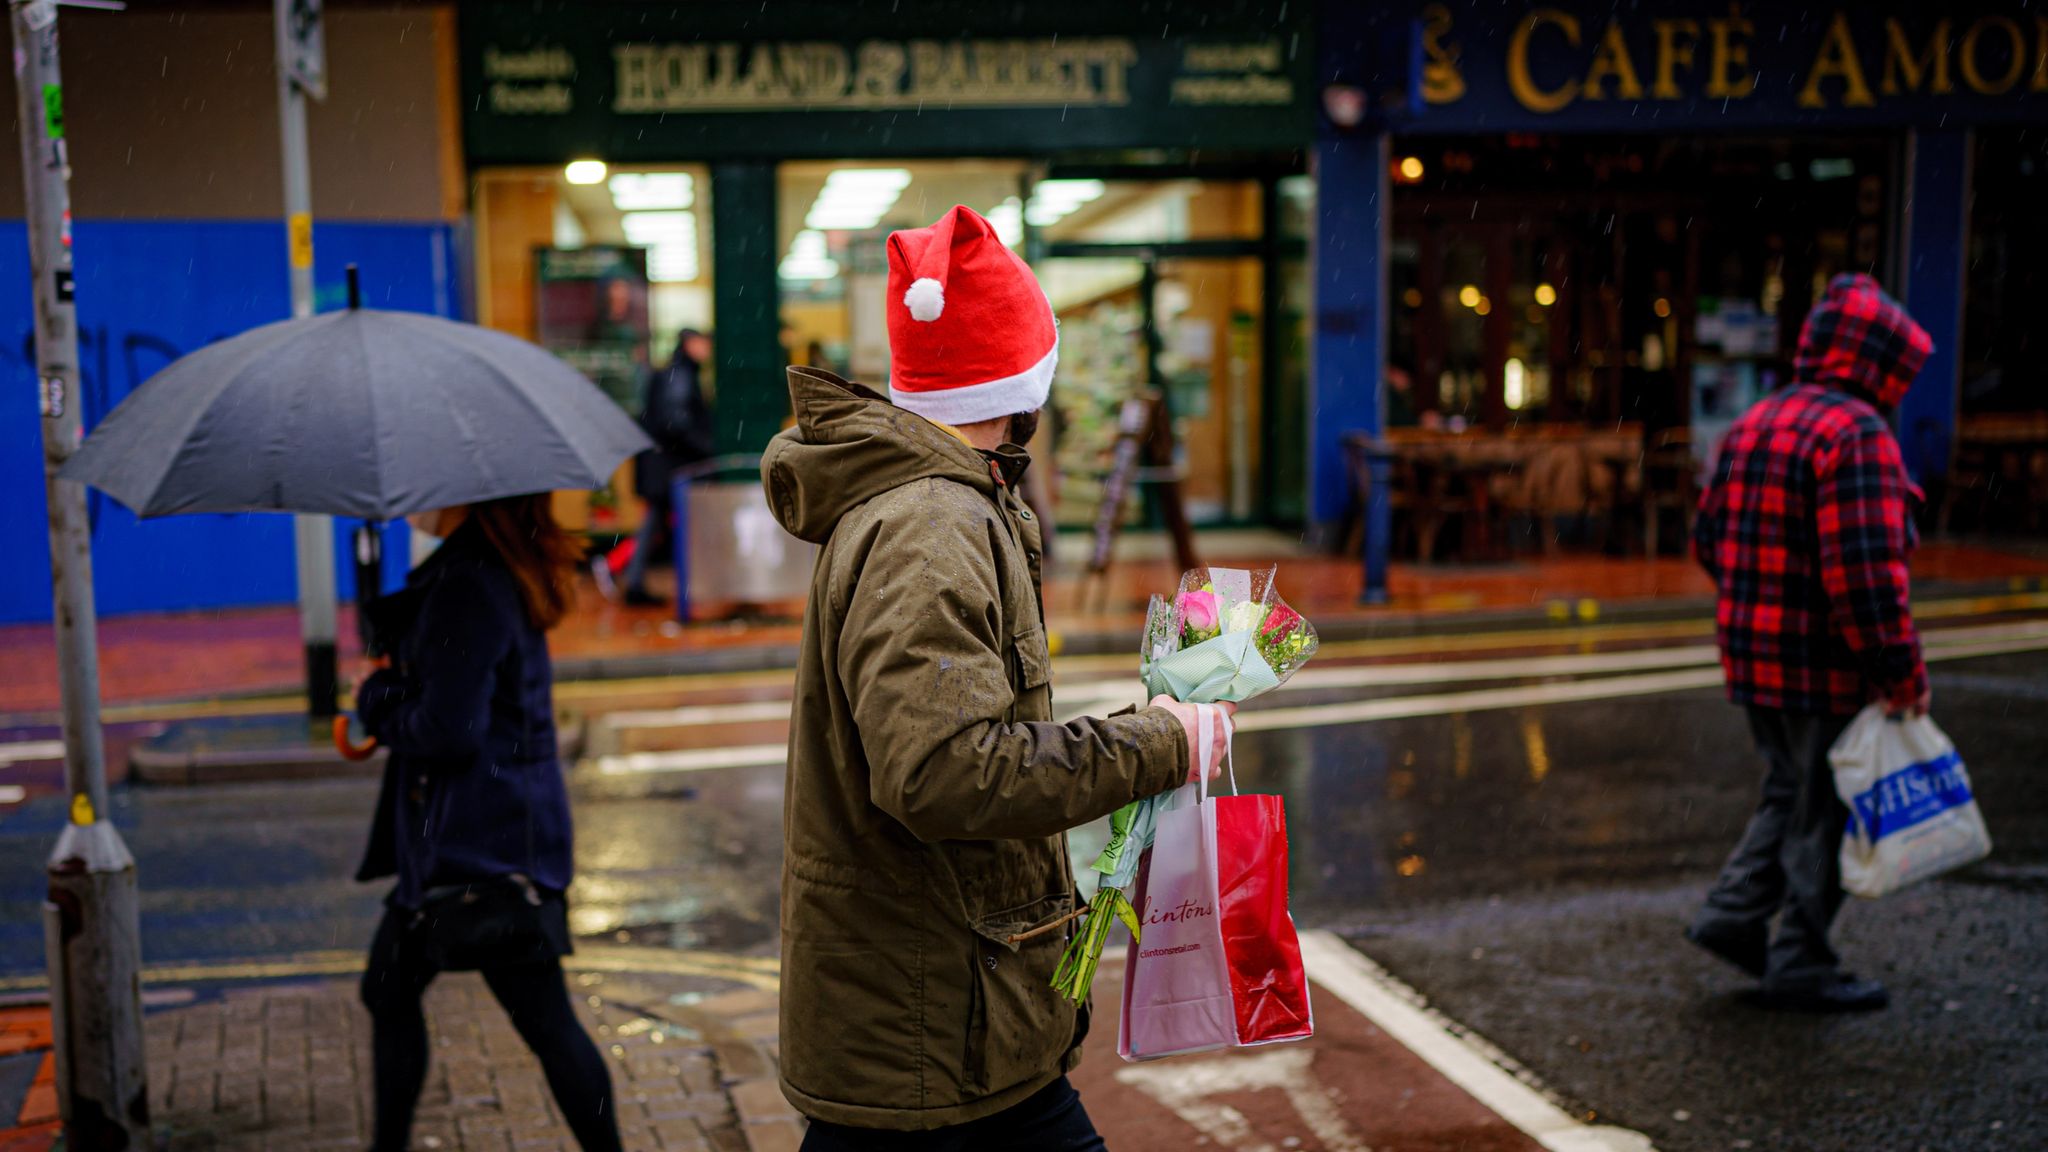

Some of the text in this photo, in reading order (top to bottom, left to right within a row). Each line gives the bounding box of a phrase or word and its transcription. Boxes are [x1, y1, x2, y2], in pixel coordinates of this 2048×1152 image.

[612, 42, 850, 112] HOLLAND
[911, 37, 1138, 107] BARRETT
[1506, 1, 1757, 113] CAFÉ
[1141, 896, 1214, 926] lintons
